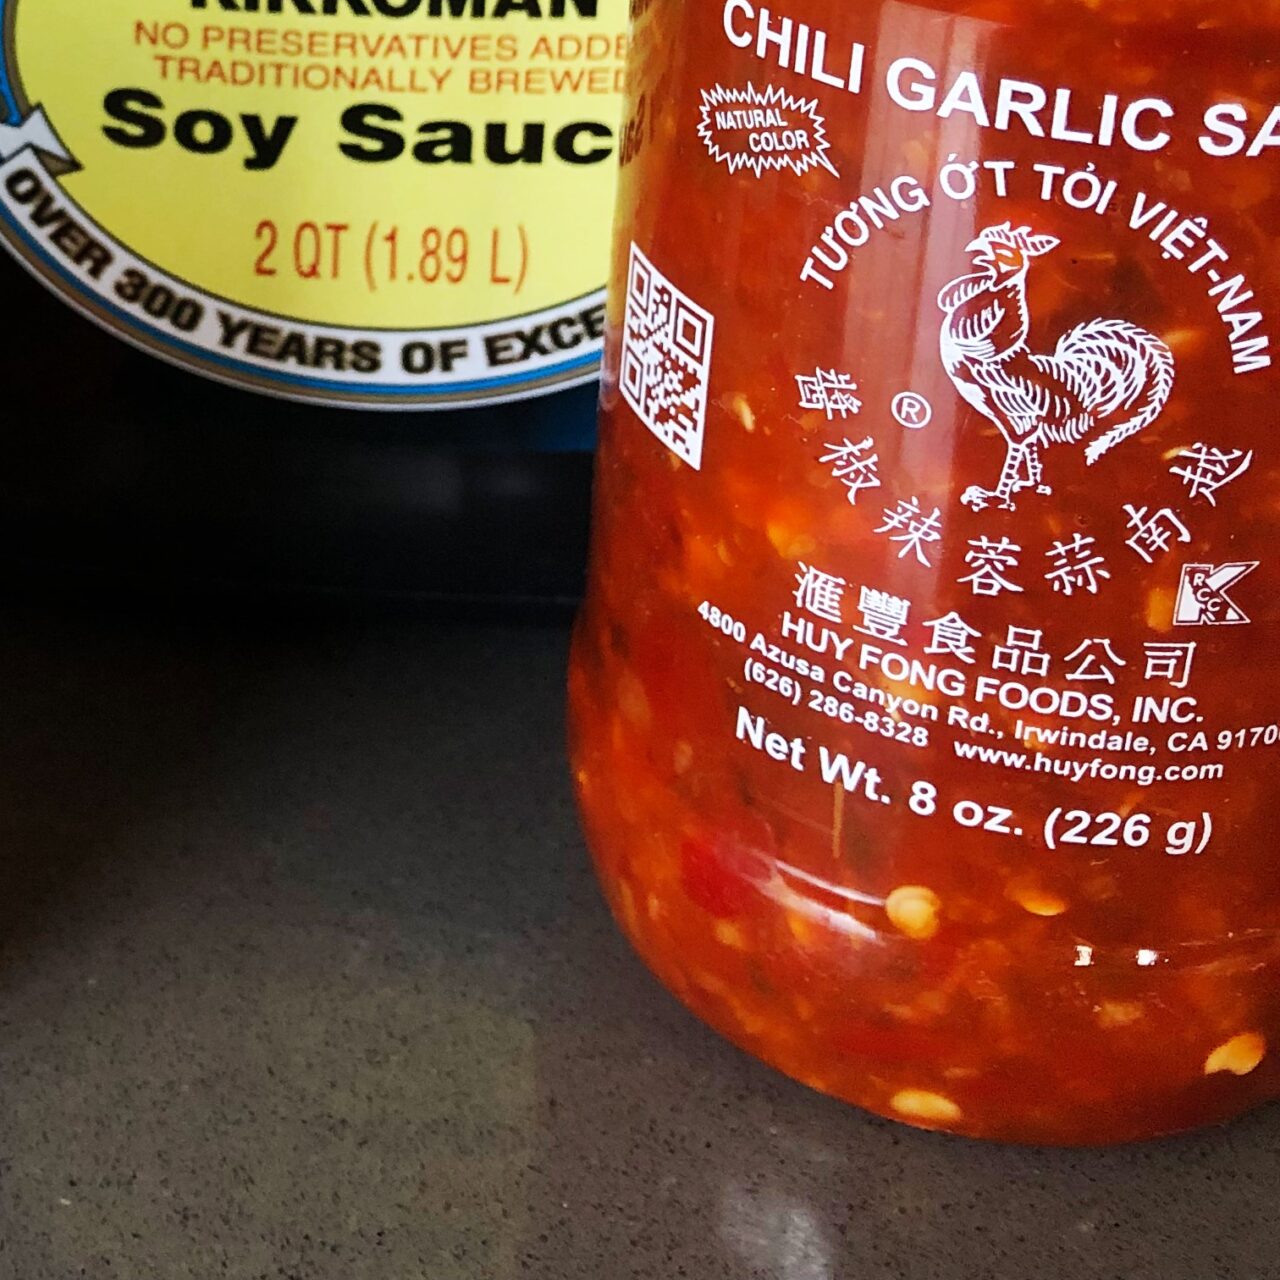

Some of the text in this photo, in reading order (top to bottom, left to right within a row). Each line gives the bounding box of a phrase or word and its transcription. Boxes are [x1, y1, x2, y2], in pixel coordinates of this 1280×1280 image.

[135, 21, 189, 50] NO
[203, 23, 519, 62] PRESERVATIVES
[155, 55, 452, 93] TRADITIONALLY
[102, 88, 613, 170] Soy Sauc
[715, 107, 788, 130] NATURAL
[750, 129, 810, 151] COLOR
[886, 57, 1172, 151] GARLIC
[1033, 162, 1118, 215] TỎI
[5, 167, 110, 280] OVER
[114, 268, 203, 333] 300
[217, 311, 381, 375] YEARS
[401, 339, 467, 375] OF
[255, 220, 528, 293] 2 QT (1.89 L)
[697, 599, 746, 643] 4800
[750, 632, 825, 682] Azusa
[833, 673, 938, 725] Canyon
[1015, 719, 1156, 755] Irwindale,
[1167, 732, 1209, 752] CA
[1216, 724, 1280, 750] 9170
[781, 611, 1204, 726] HUY FONG FOODS, INC.
[743, 658, 1224, 786] (626) 286-8328 www.huyfong.com
[736, 706, 1212, 855] Net Wt. 8 oz. (226 g)
